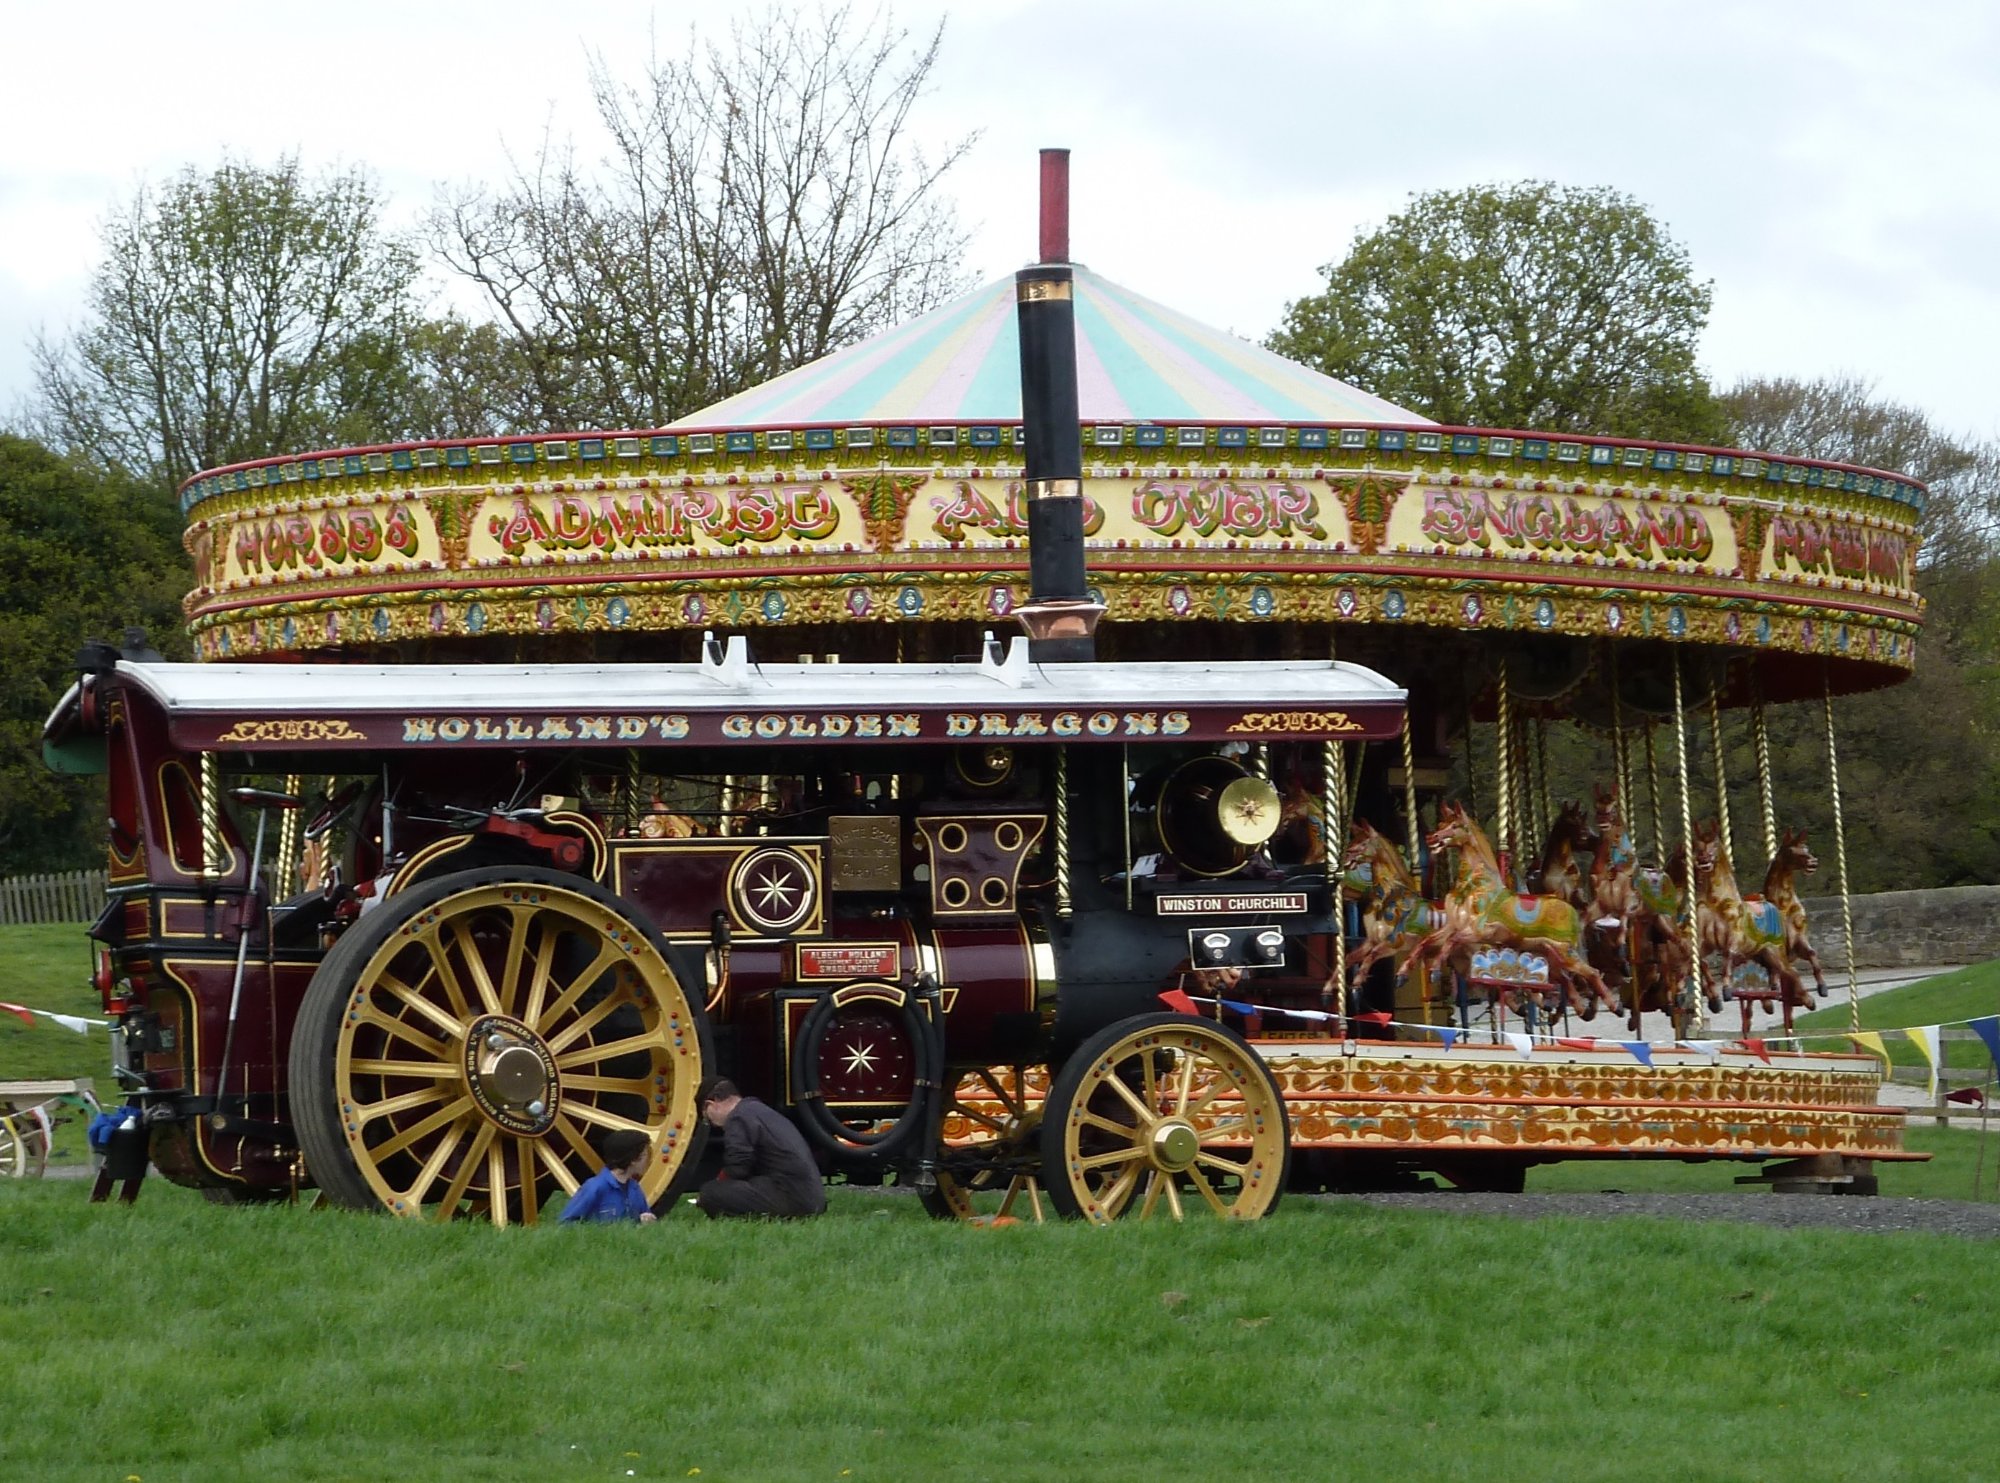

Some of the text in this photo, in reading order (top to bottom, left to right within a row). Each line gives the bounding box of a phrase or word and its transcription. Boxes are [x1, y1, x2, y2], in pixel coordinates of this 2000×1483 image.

[235, 501, 419, 576] HORSES
[489, 486, 840, 556] ADMIRED
[1131, 479, 1328, 541] OVER
[1420, 488, 1714, 562] ENGLAND
[402, 711, 1192, 742] HOLLAND'S GOLDEN DRAGONS
[1163, 897, 1301, 911] WINSTON CHURCHILL
[811, 951, 843, 959] ALBERT
[467, 1050, 476, 1071] SONS
